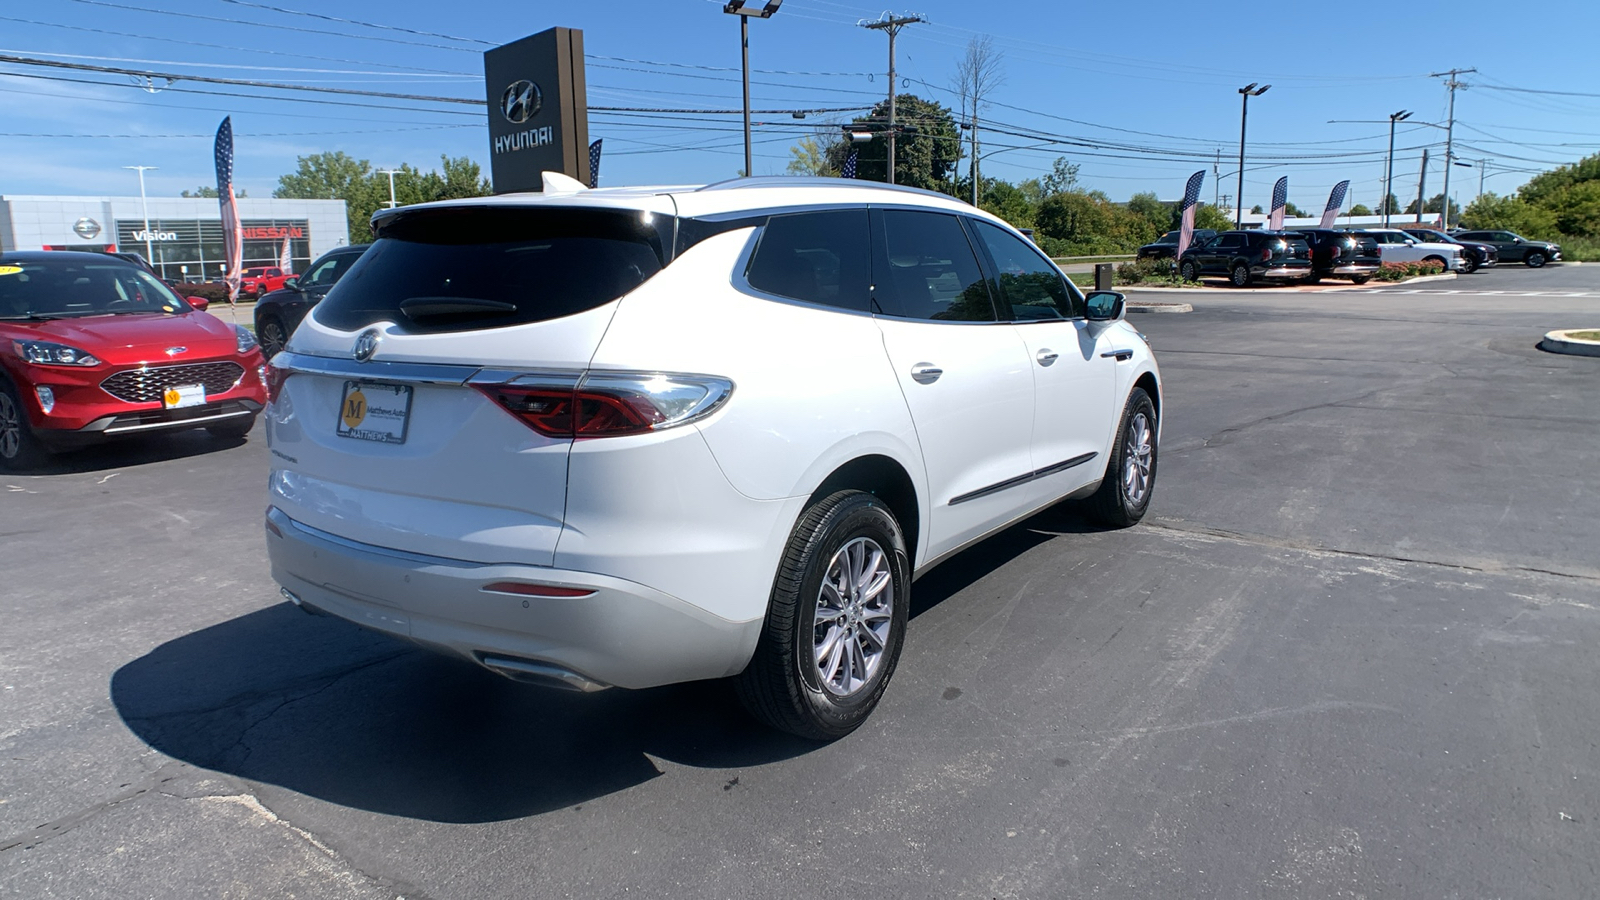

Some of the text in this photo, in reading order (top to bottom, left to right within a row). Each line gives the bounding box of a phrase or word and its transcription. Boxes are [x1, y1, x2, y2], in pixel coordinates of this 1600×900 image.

[494, 126, 553, 154] HYUNDAI
[132, 229, 177, 241] Vision
[242, 227, 303, 239] NISSAN
[345, 400, 363, 419] M
[349, 430, 388, 442] MATTHEWS
